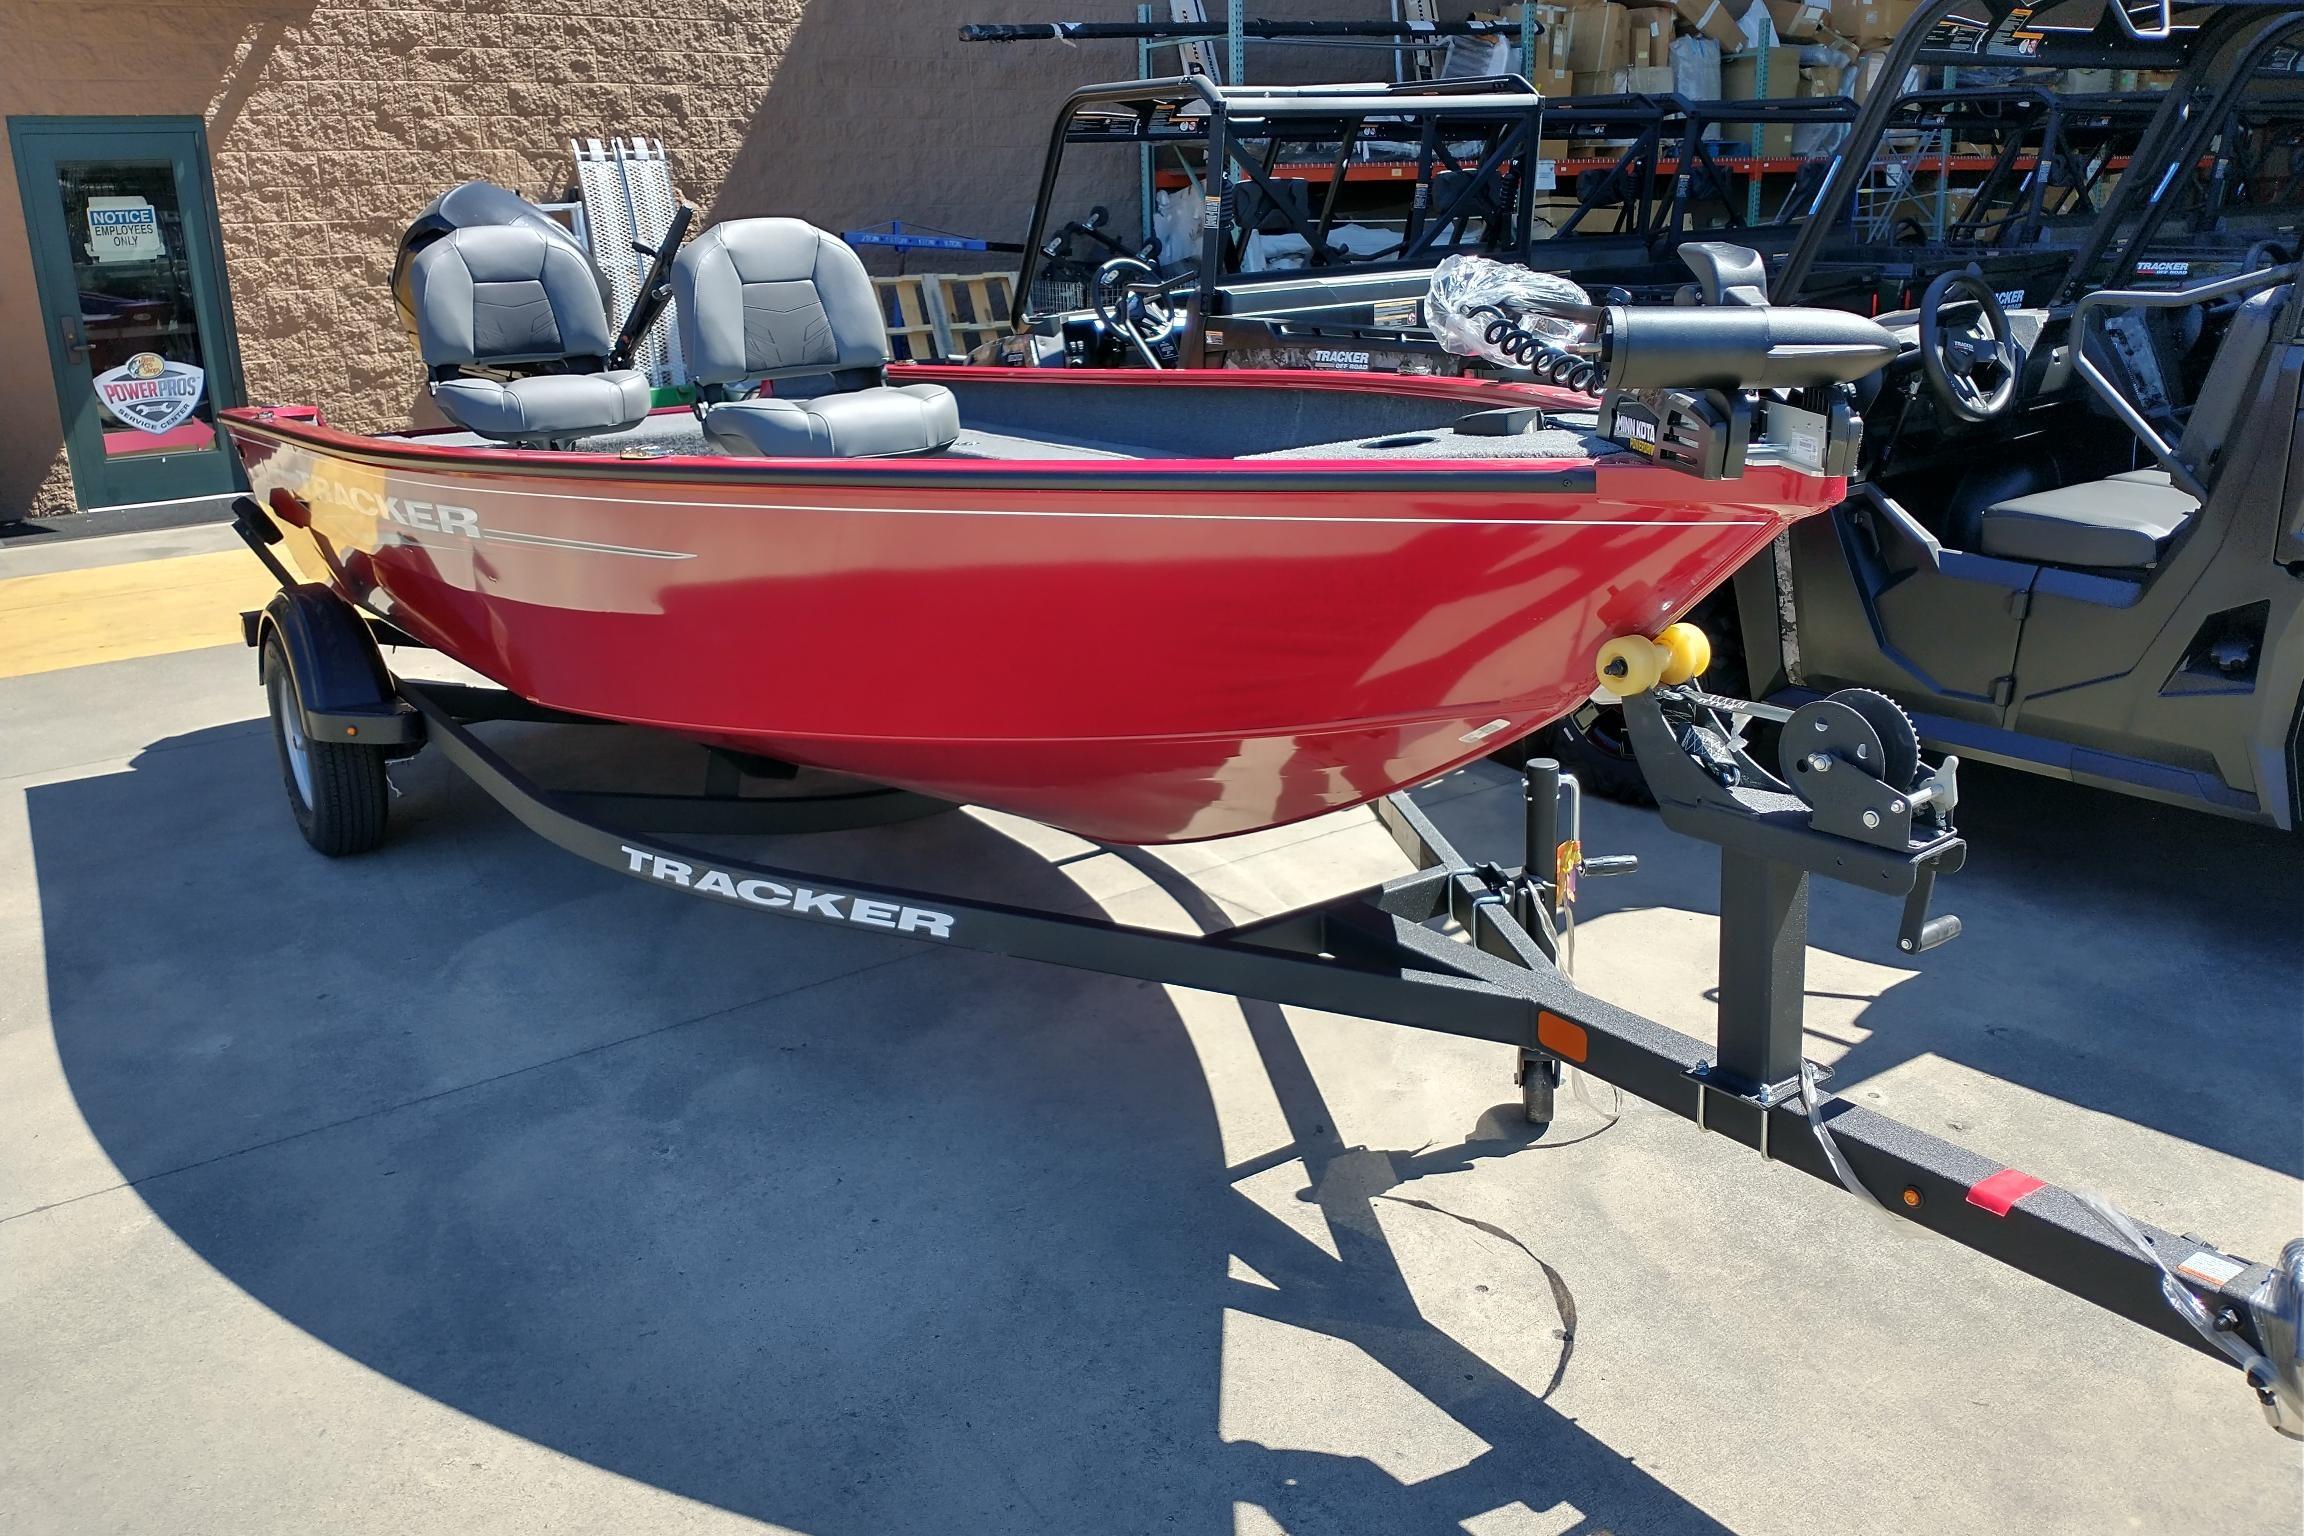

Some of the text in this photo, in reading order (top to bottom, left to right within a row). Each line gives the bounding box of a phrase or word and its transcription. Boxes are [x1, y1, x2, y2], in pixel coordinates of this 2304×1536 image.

[93, 211, 151, 224] NOTICE
[94, 224, 154, 237] EMPLOYEES
[113, 235, 139, 247] ONLY
[2136, 262, 2189, 270] TRACKER
[1995, 290, 2025, 304] CKER
[1315, 350, 1370, 363] TRACKER
[118, 403, 190, 431] SERVICE CENTER
[1615, 411, 1656, 443] MINN KOTA
[297, 469, 481, 539] TRACKER
[621, 844, 955, 938] TRACKER
